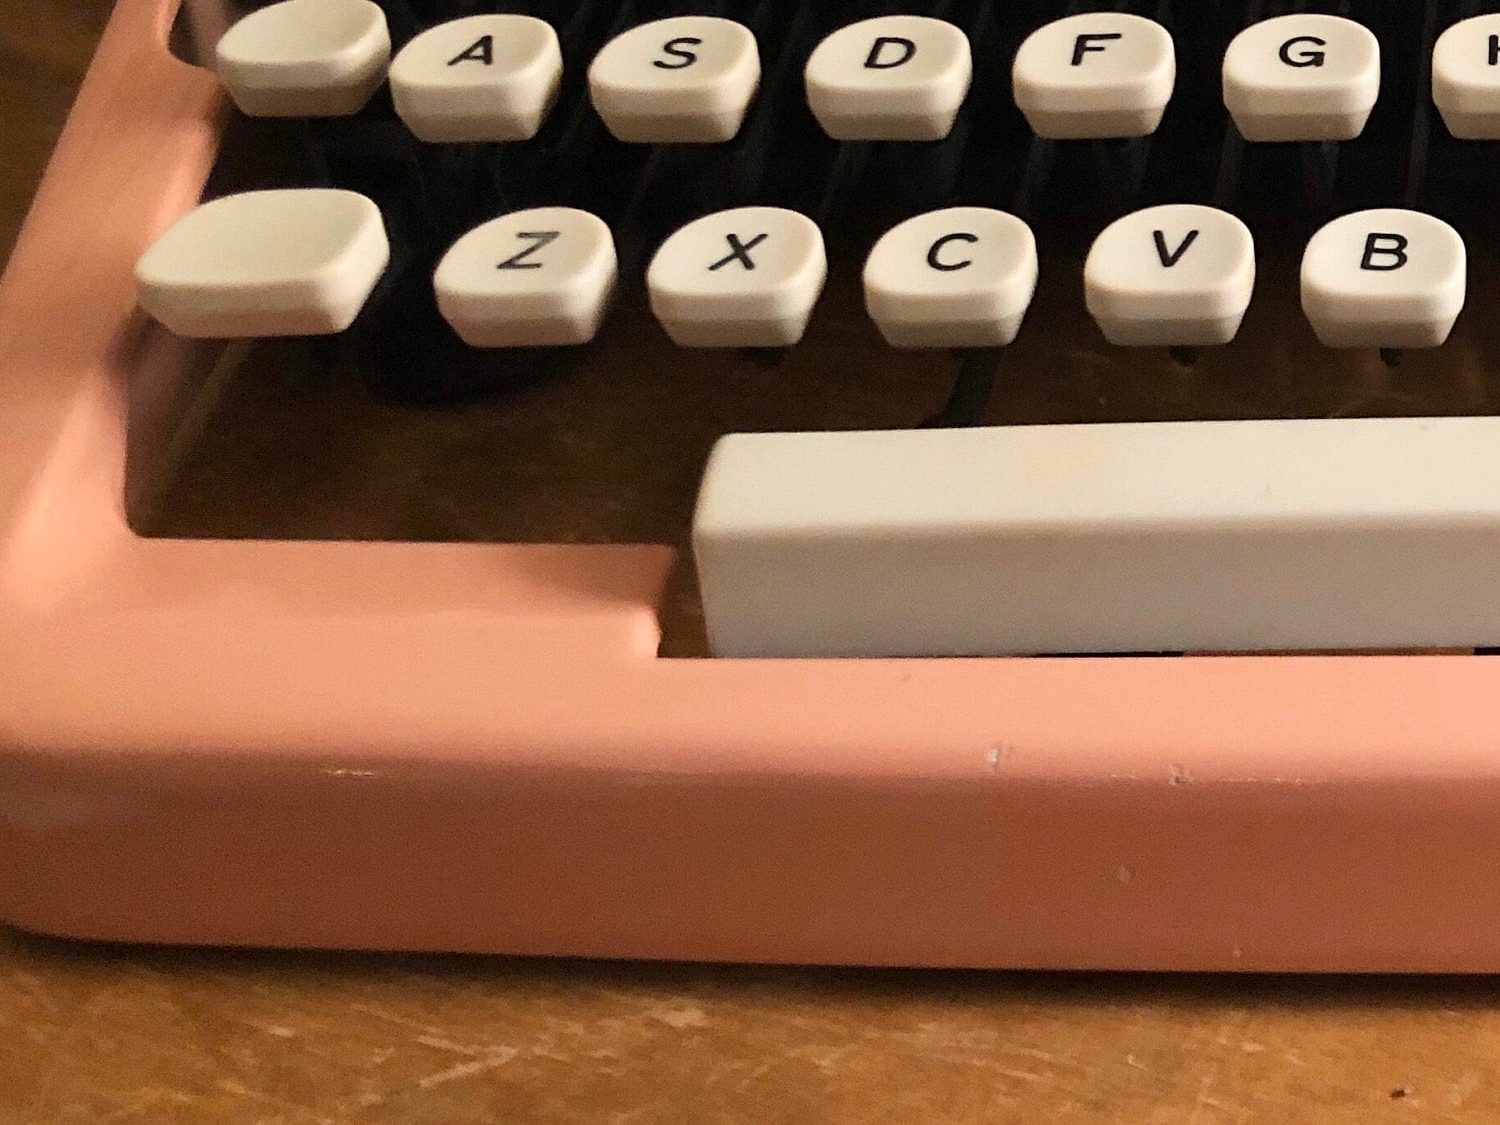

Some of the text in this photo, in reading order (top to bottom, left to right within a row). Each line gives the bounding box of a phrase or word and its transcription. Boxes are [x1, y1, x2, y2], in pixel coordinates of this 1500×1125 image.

[446, 34, 494, 67] A
[652, 36, 703, 70] S
[863, 36, 917, 70] D
[1070, 32, 1123, 67] F
[1278, 35, 1327, 68] G
[496, 230, 561, 270] Z
[707, 233, 769, 272] X
[925, 232, 979, 272] C
[1152, 229, 1200, 268] V
[1359, 232, 1409, 272] B
